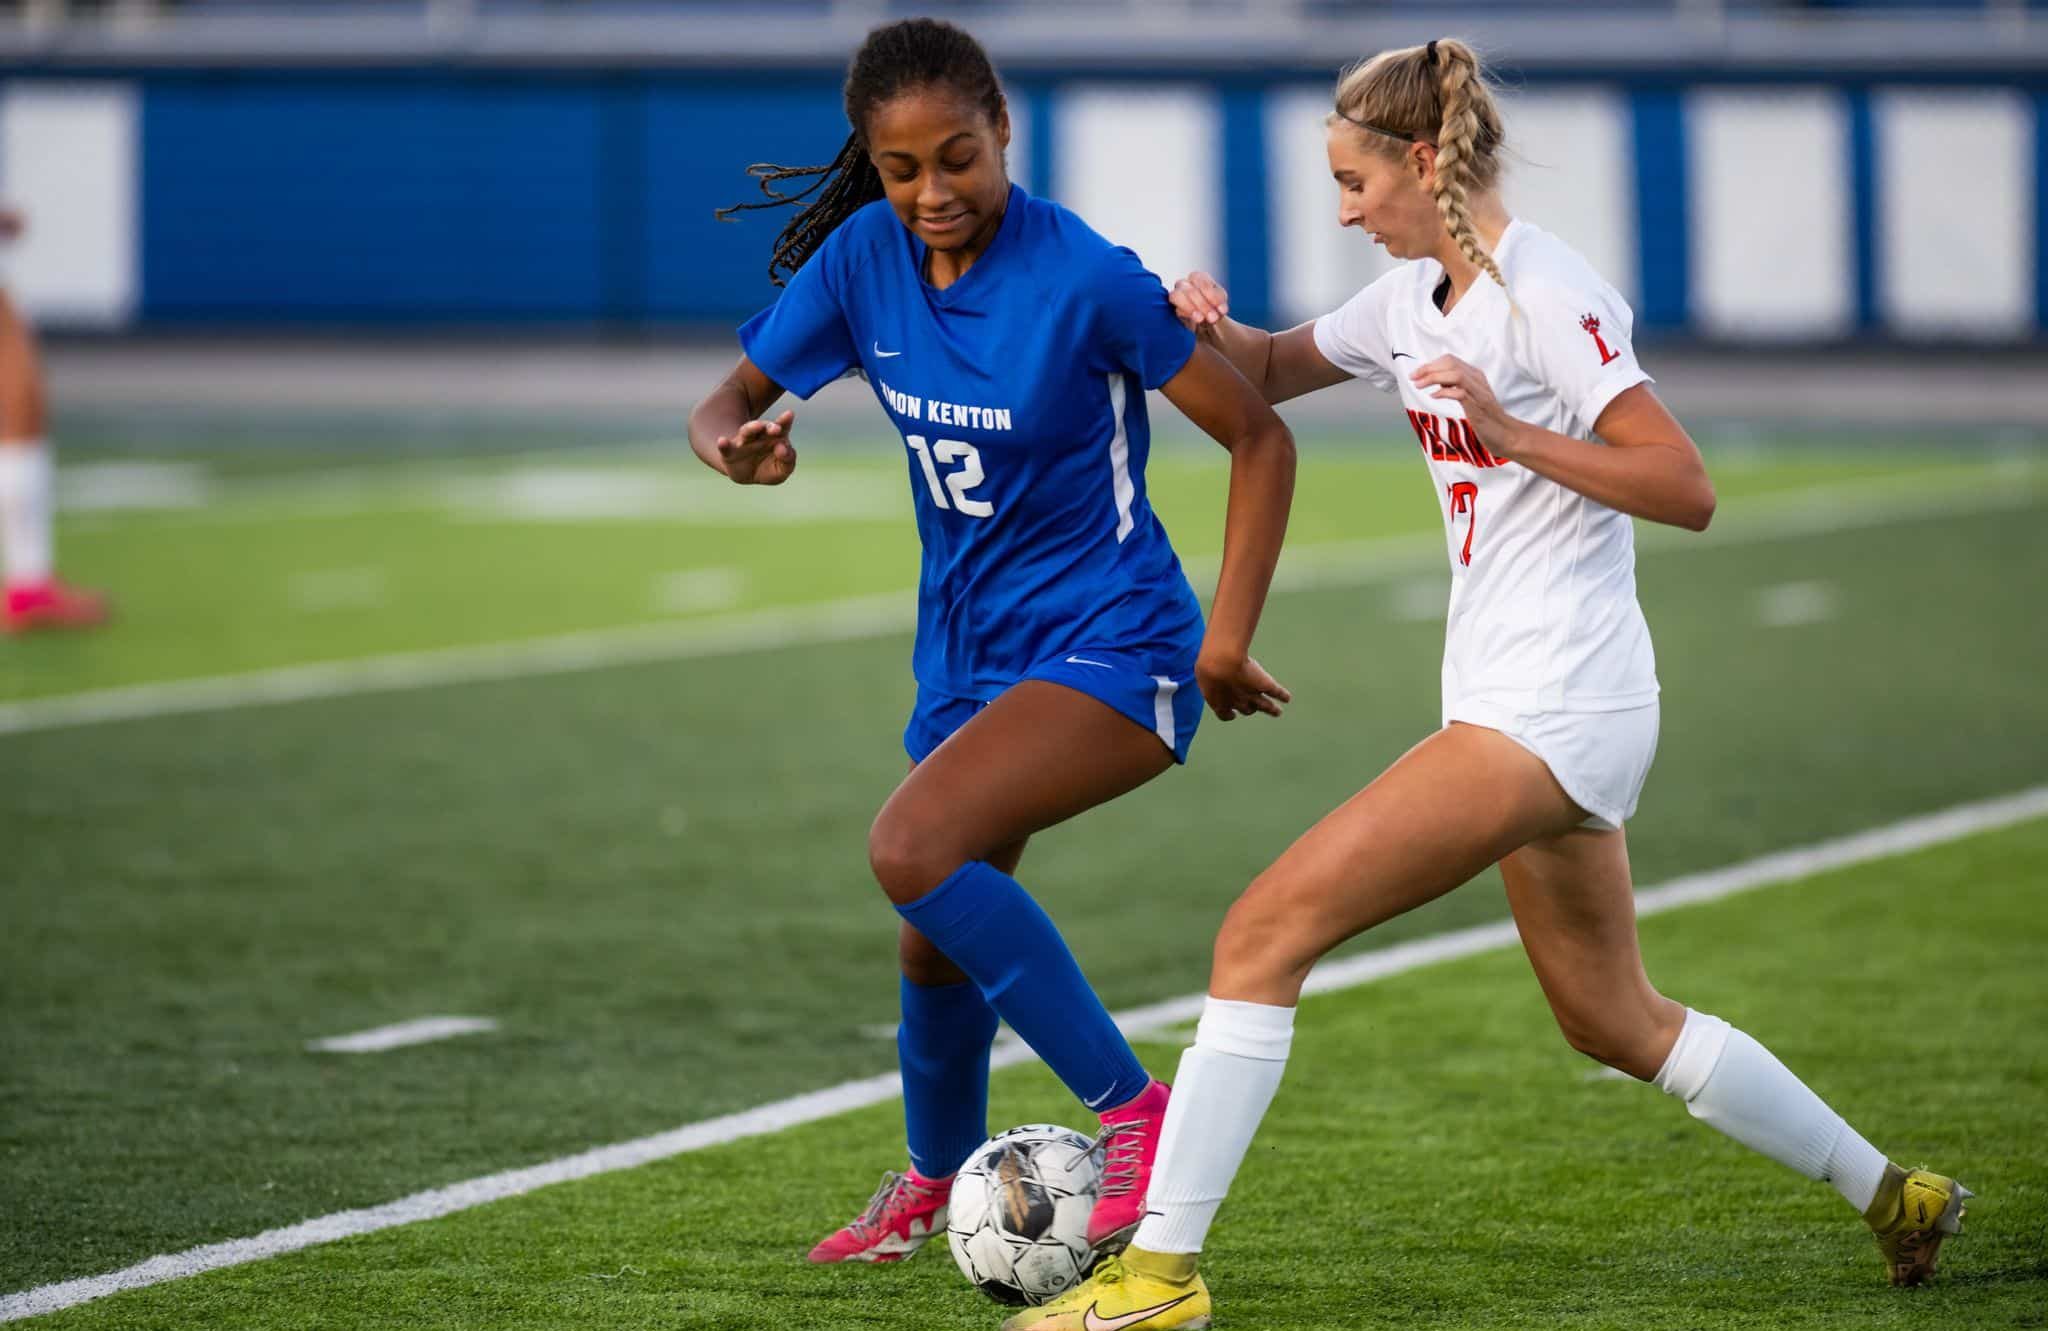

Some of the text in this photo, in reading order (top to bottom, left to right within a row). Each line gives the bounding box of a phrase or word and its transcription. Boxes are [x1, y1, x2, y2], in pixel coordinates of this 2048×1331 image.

[1586, 324, 1621, 366] L
[879, 379, 1012, 430] IMON KENTON
[906, 434, 994, 517] 12
[1447, 482, 1478, 567] 7
